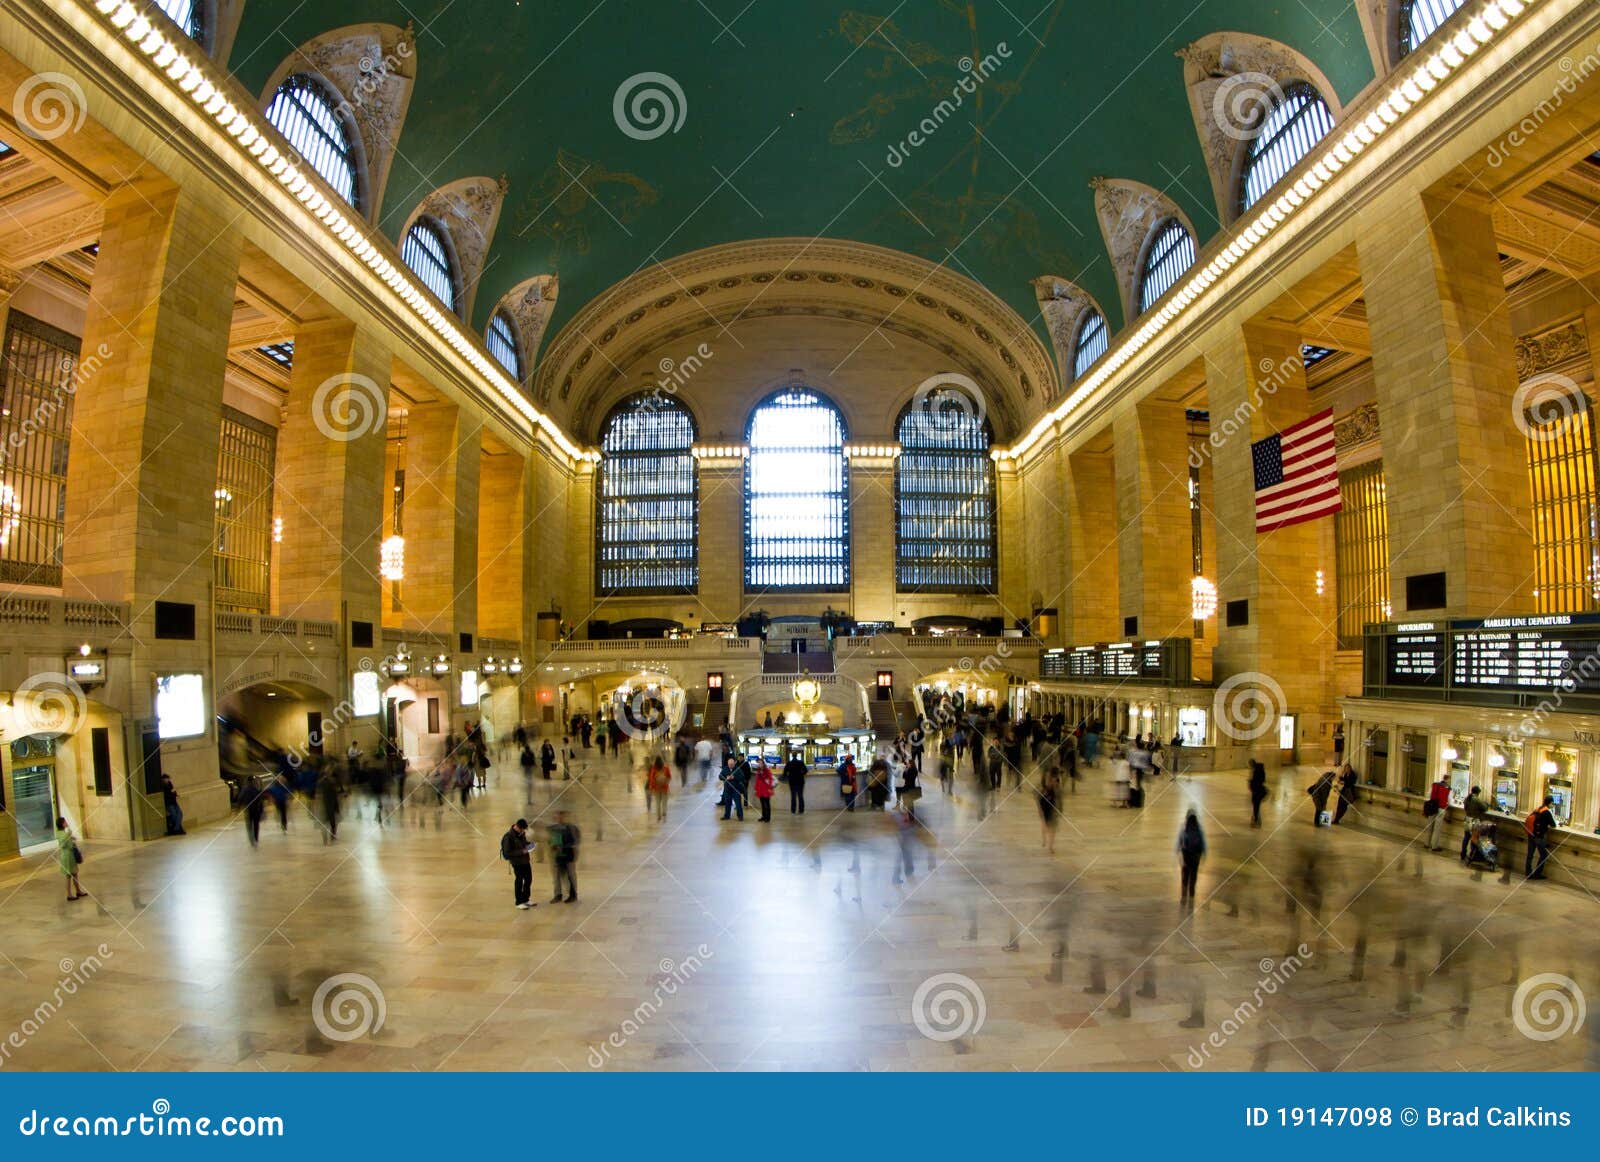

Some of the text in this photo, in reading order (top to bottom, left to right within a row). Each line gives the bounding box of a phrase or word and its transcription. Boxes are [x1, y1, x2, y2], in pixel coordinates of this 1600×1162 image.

[1484, 616, 1571, 628] HARLEM LINE DEPARTURES
[1397, 623, 1434, 632] INFORMATION
